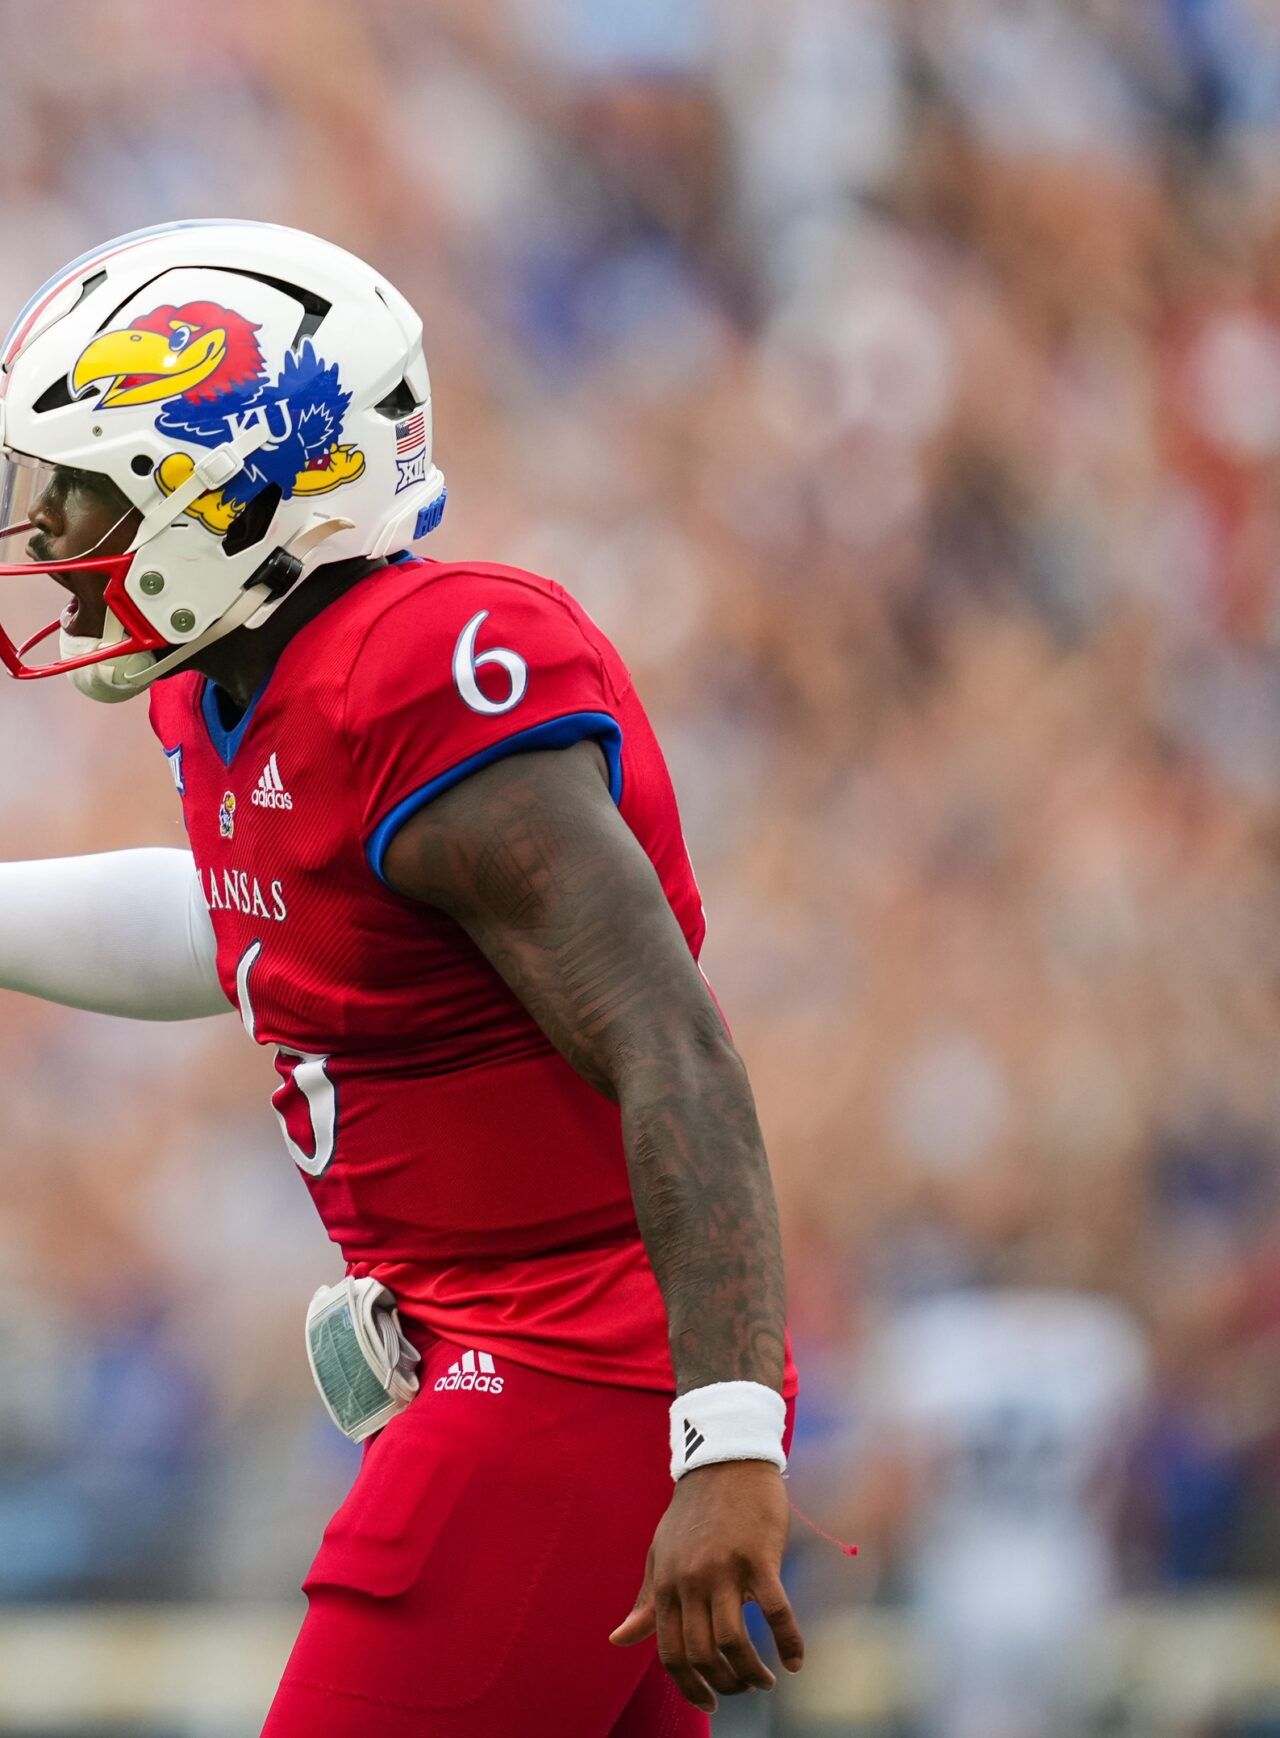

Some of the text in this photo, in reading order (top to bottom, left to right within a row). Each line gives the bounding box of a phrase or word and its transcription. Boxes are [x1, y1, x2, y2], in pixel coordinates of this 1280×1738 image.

[222, 398, 293, 451] KU
[395, 446, 426, 495] XII
[452, 609, 529, 716] 6
[251, 787, 293, 810] adidas
[434, 1370, 505, 1395] adidas
